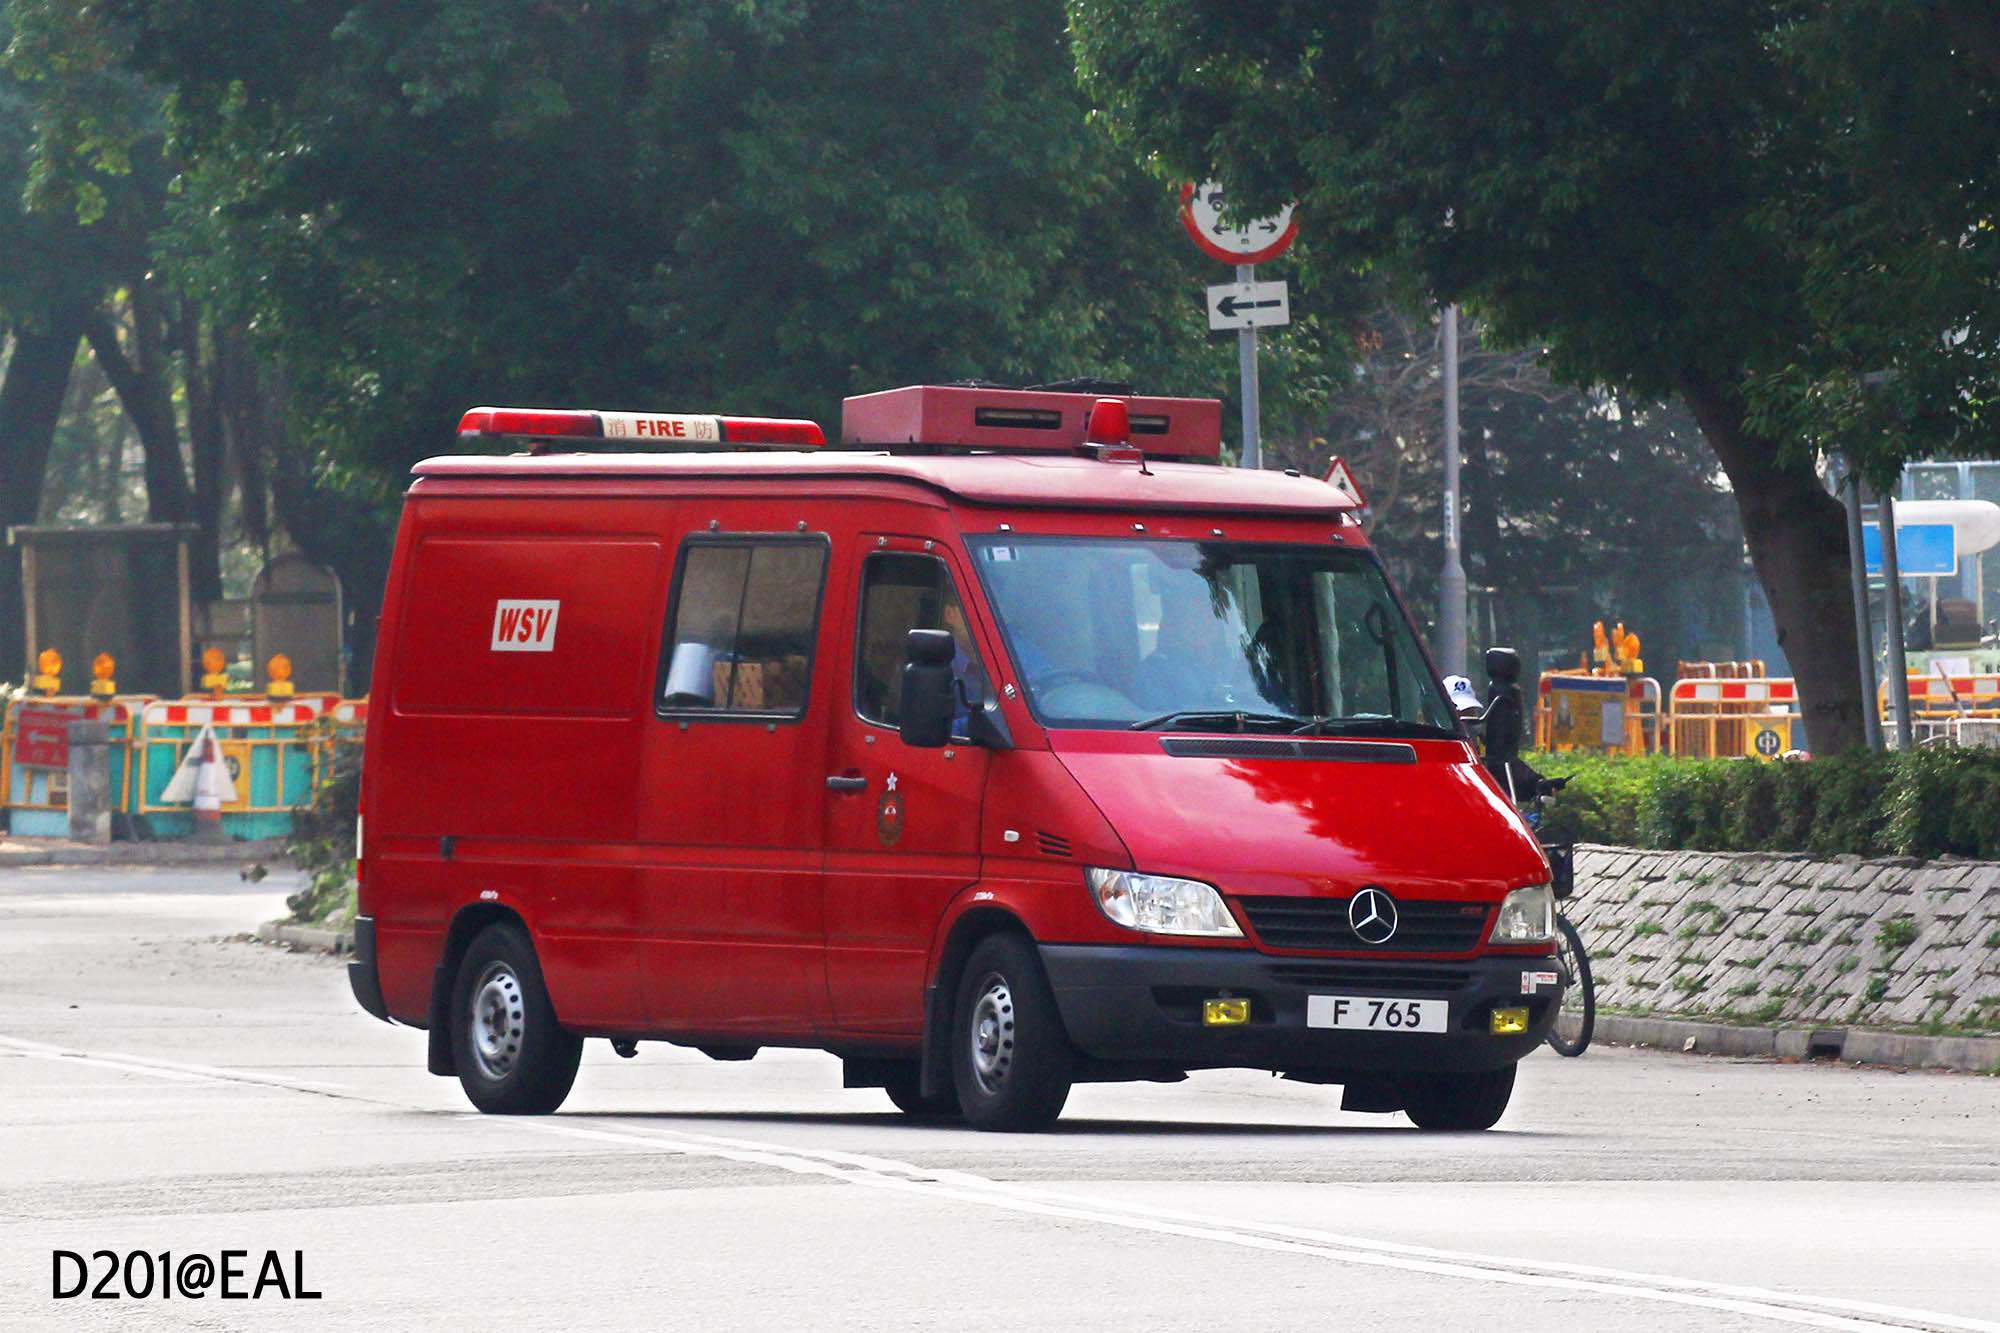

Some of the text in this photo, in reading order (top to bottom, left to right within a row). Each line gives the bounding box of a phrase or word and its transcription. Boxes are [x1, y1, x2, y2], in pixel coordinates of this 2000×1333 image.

[607, 418, 713, 439] 消 FIRE 防
[498, 607, 553, 642] WSV
[1334, 1000, 1421, 1028] F 765
